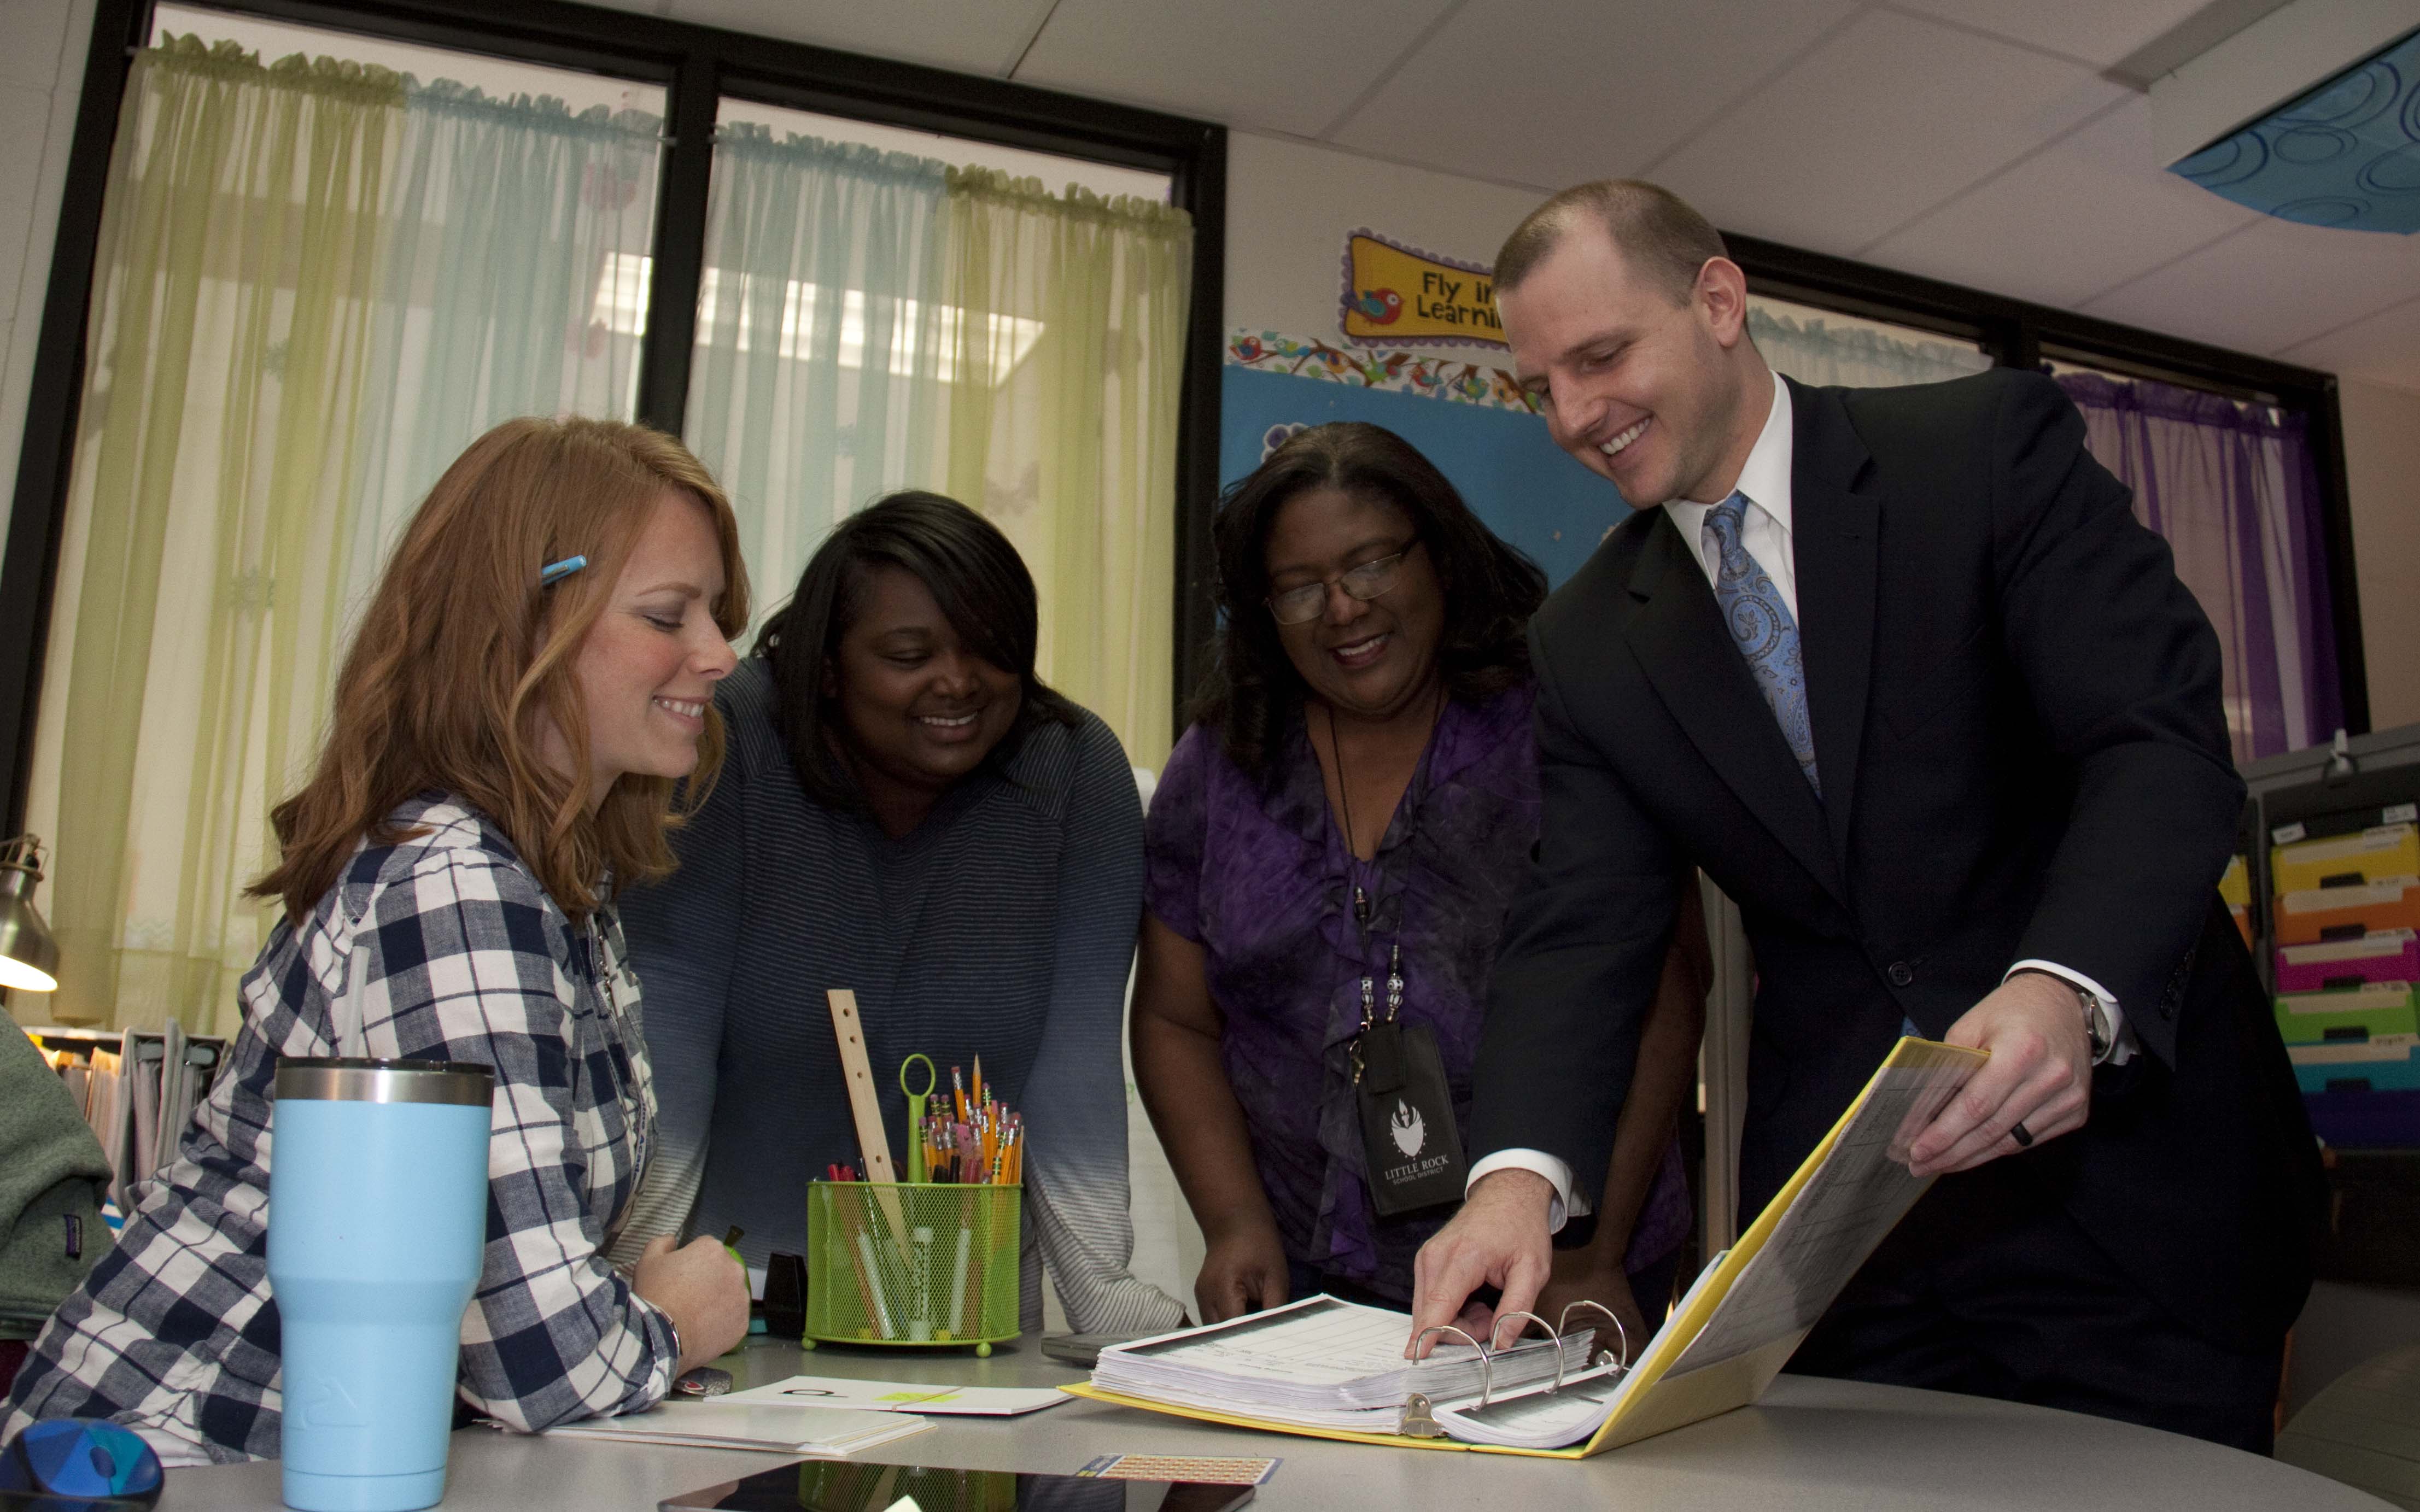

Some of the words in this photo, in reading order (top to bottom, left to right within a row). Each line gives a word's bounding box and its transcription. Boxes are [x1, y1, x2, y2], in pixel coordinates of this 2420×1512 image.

[1423, 271, 1461, 303] Fly
[1417, 294, 1502, 329] Learni
[1384, 1163, 1419, 1180] LITTLE
[1421, 1154, 1449, 1170] ROCK
[1393, 1174, 1417, 1186] SCHOOL
[1417, 1166, 1443, 1179] DISTRICT
